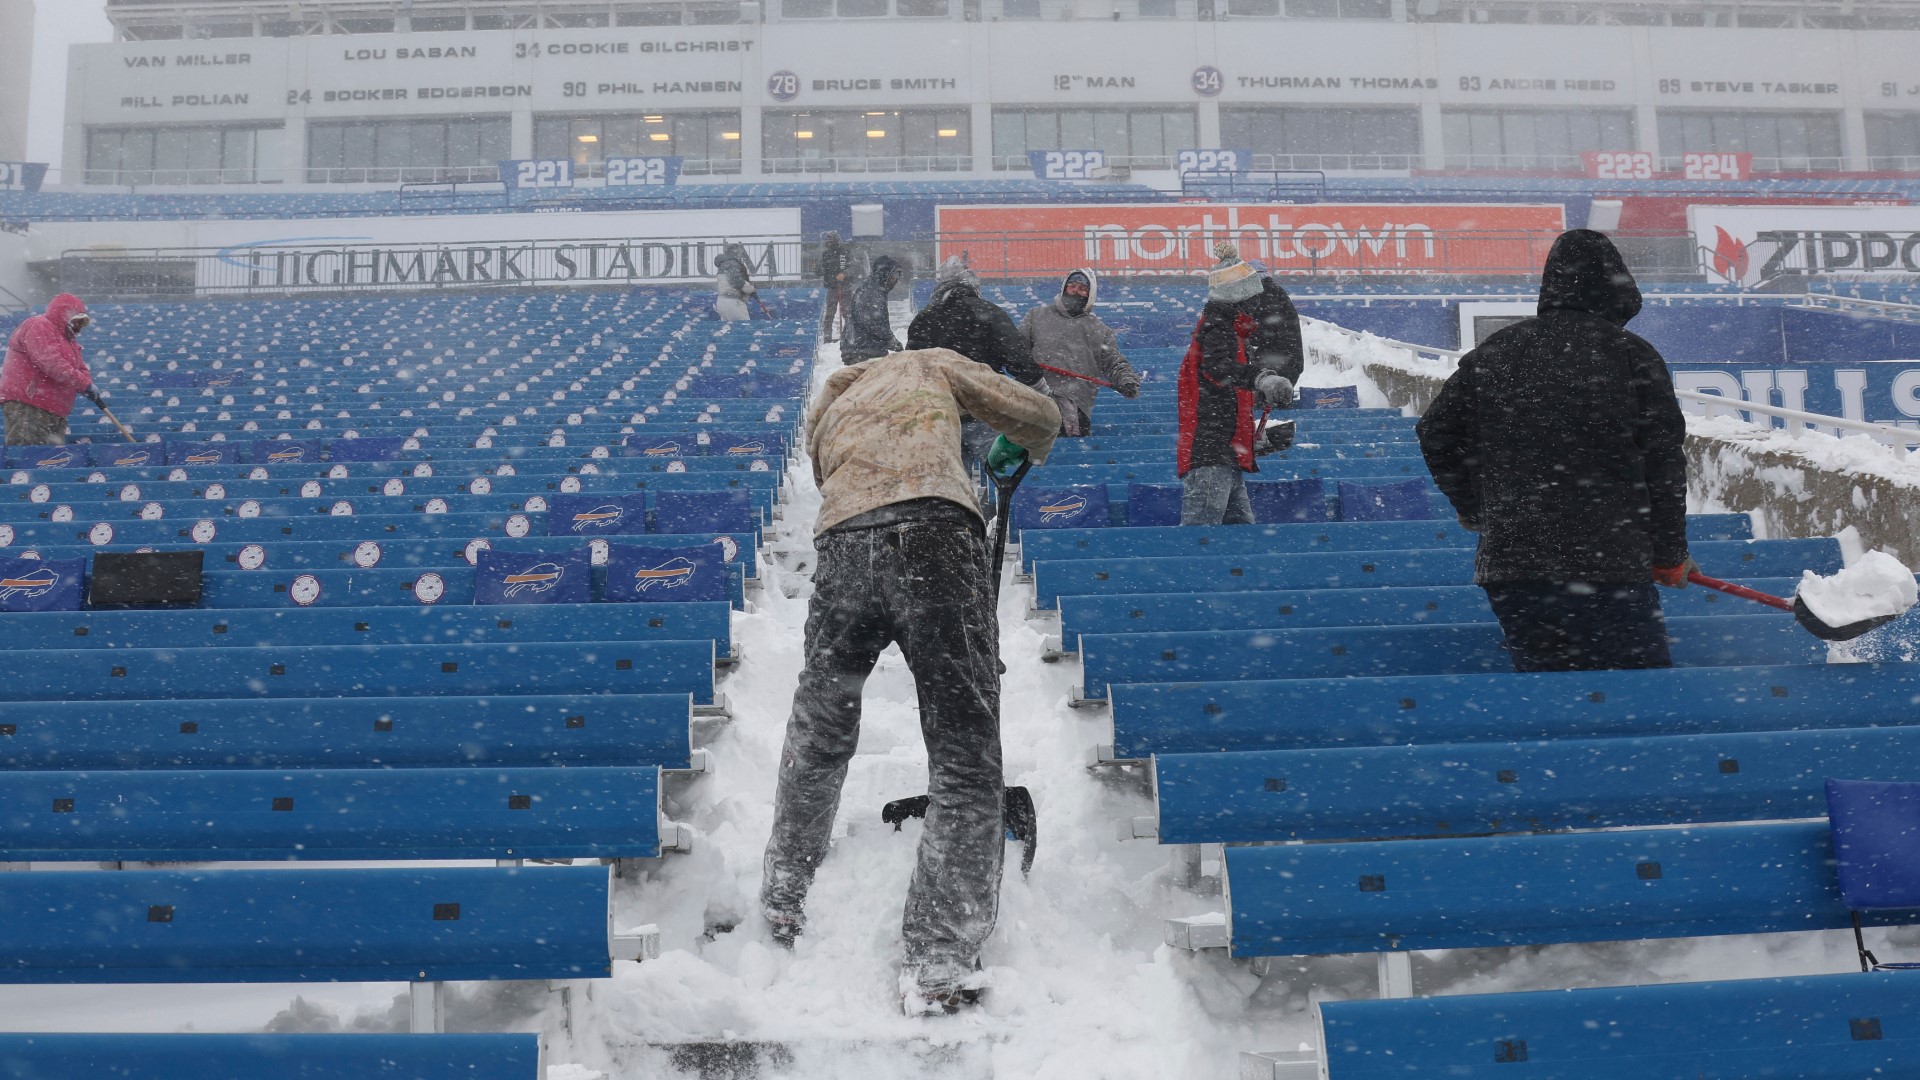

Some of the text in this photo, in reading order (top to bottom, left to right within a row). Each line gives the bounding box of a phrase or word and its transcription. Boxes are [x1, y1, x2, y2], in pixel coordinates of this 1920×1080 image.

[344, 46, 476, 61] LOU SABAN
[515, 40, 754, 58] 34 COOKIE GILCHRIST
[123, 53, 251, 67] VAN MILLER
[563, 80, 742, 97] 90 PHIL HANSEN
[772, 75, 956, 94] 78 BRUCE SMITH
[1086, 76, 1135, 88] MAN
[1195, 71, 1438, 90] 34 THURMAN THOMAS
[1488, 78, 1557, 91] ANDRE
[1563, 79, 1616, 91] REED
[1658, 78, 1839, 94] 89 STEVE TASKER
[1881, 82, 1897, 97] 51
[172, 93, 249, 107] POLIAN
[287, 85, 533, 105] 24 BOOKER EDGERSON
[608, 158, 666, 186] 222
[1046, 151, 1103, 179] 222
[1179, 151, 1238, 177] 223
[1597, 153, 1652, 180] 223
[1684, 154, 1739, 180] 224
[518, 160, 572, 188] 221
[1084, 207, 1434, 261] northtown
[251, 240, 778, 286] HIGHMARK STADIUM
